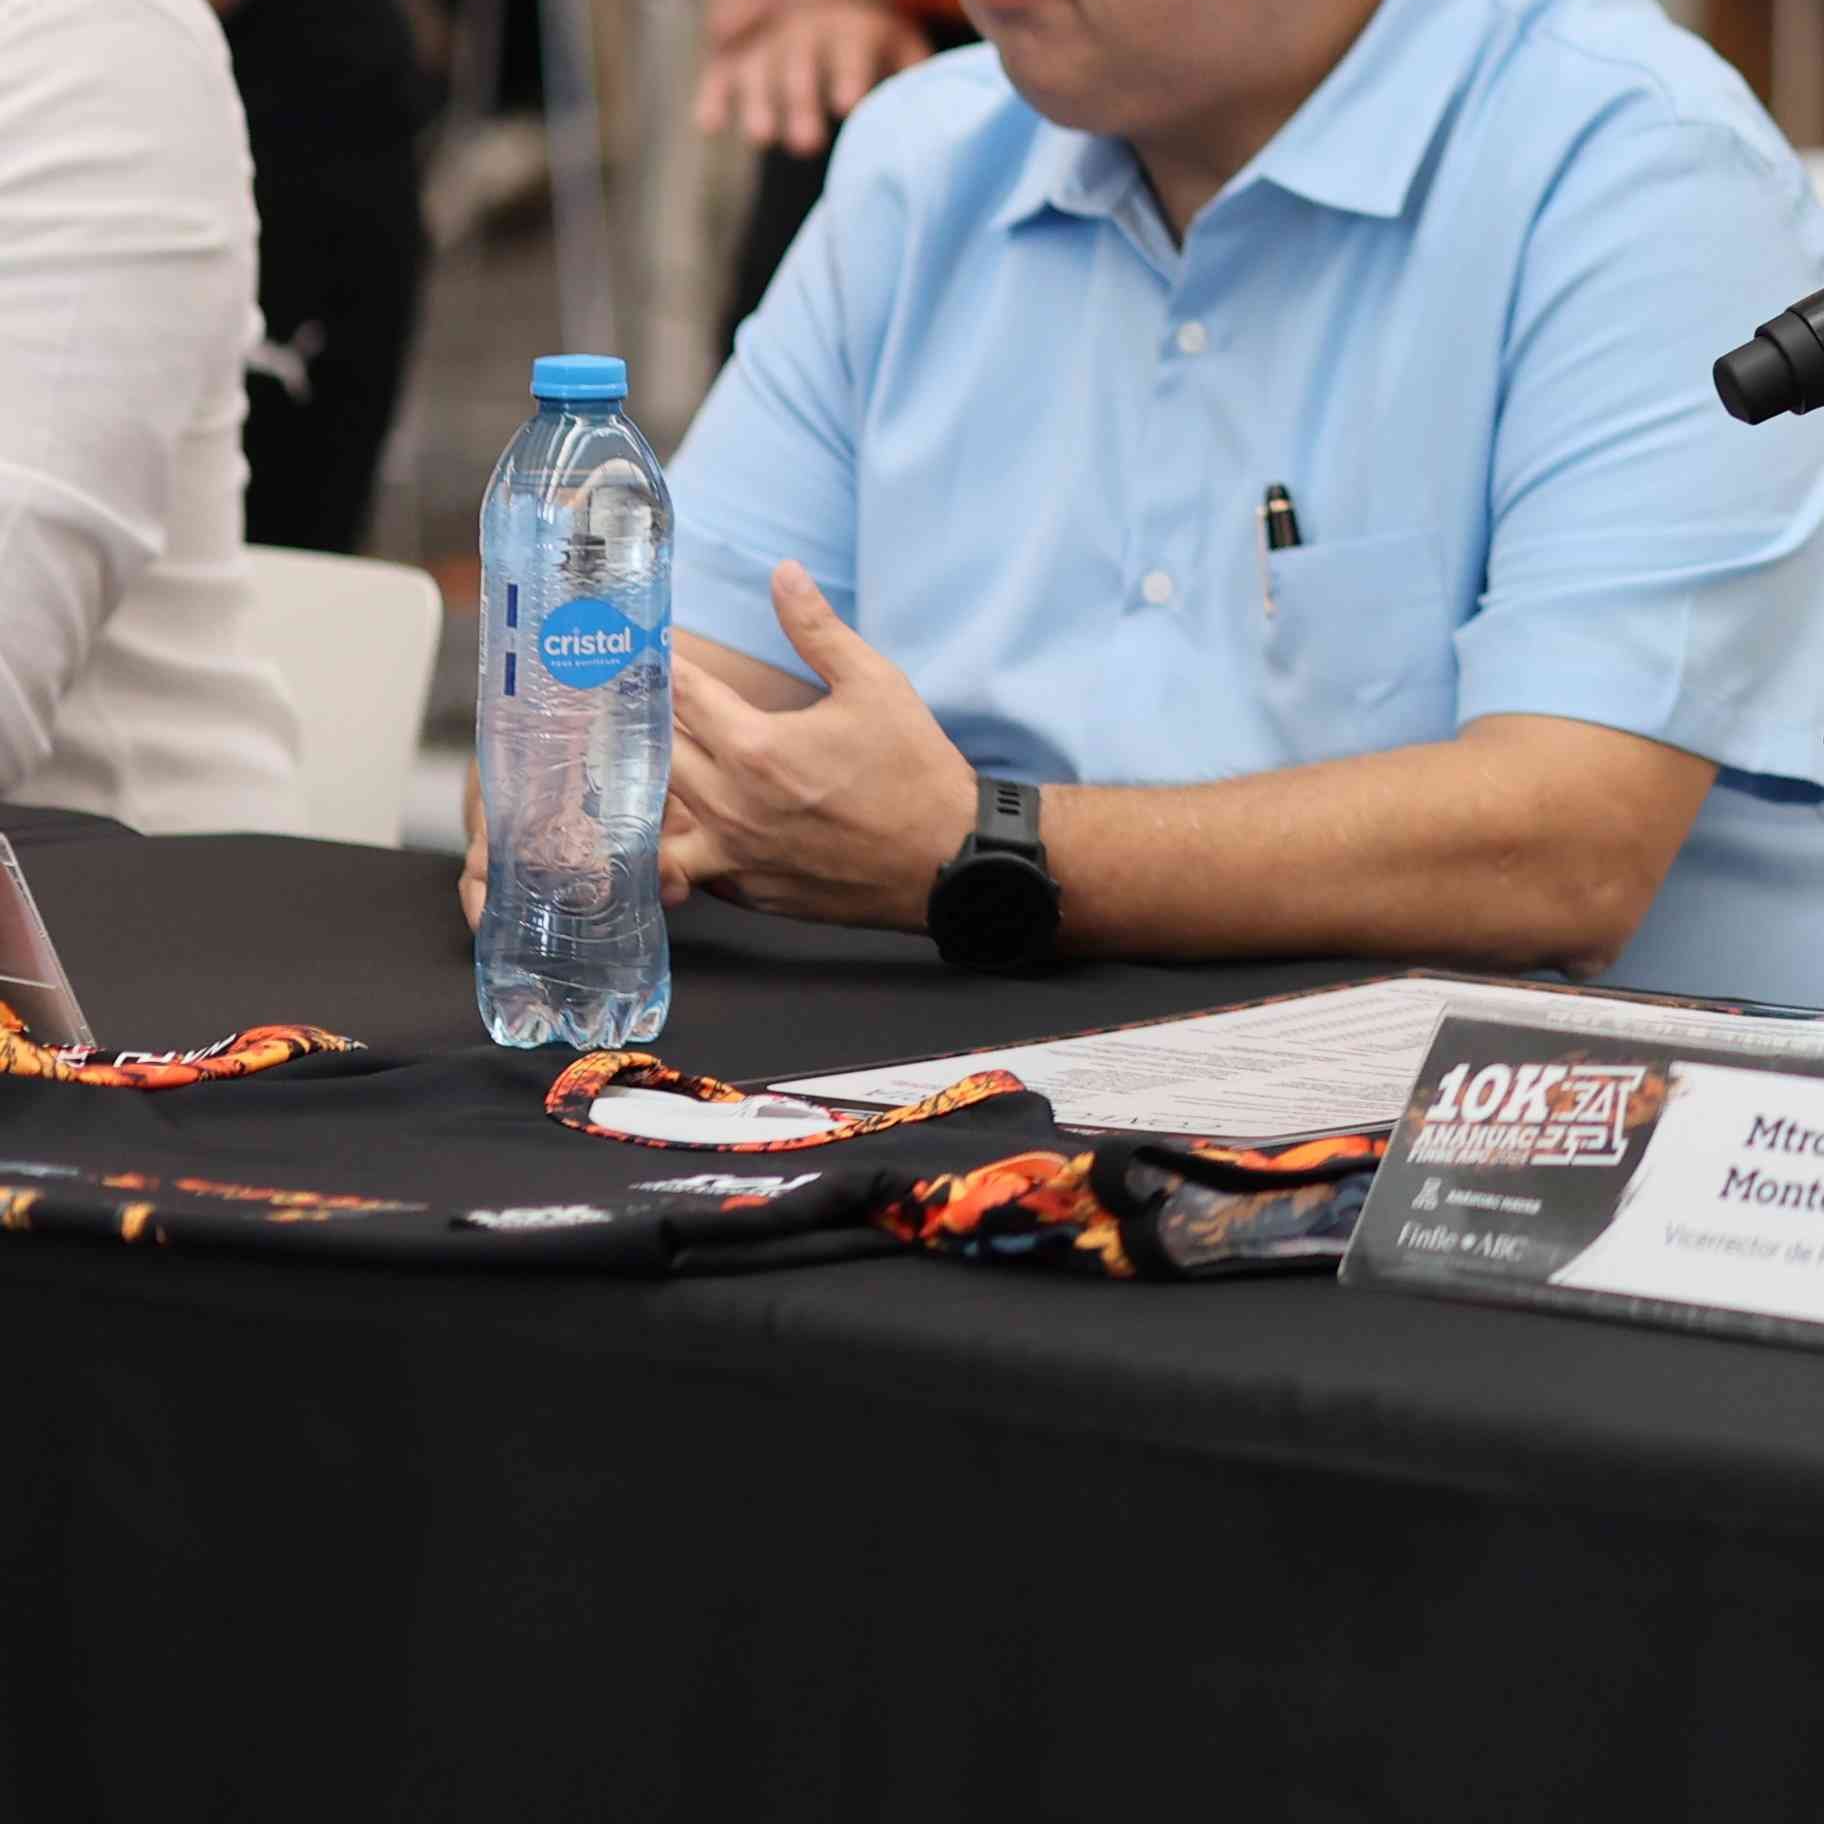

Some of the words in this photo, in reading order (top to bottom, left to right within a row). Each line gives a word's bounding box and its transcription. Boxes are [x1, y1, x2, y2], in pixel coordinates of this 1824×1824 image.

[543, 625, 632, 657] cristal
[1423, 1062, 1569, 1123] 10K
[1784, 1240, 1813, 1266] de
